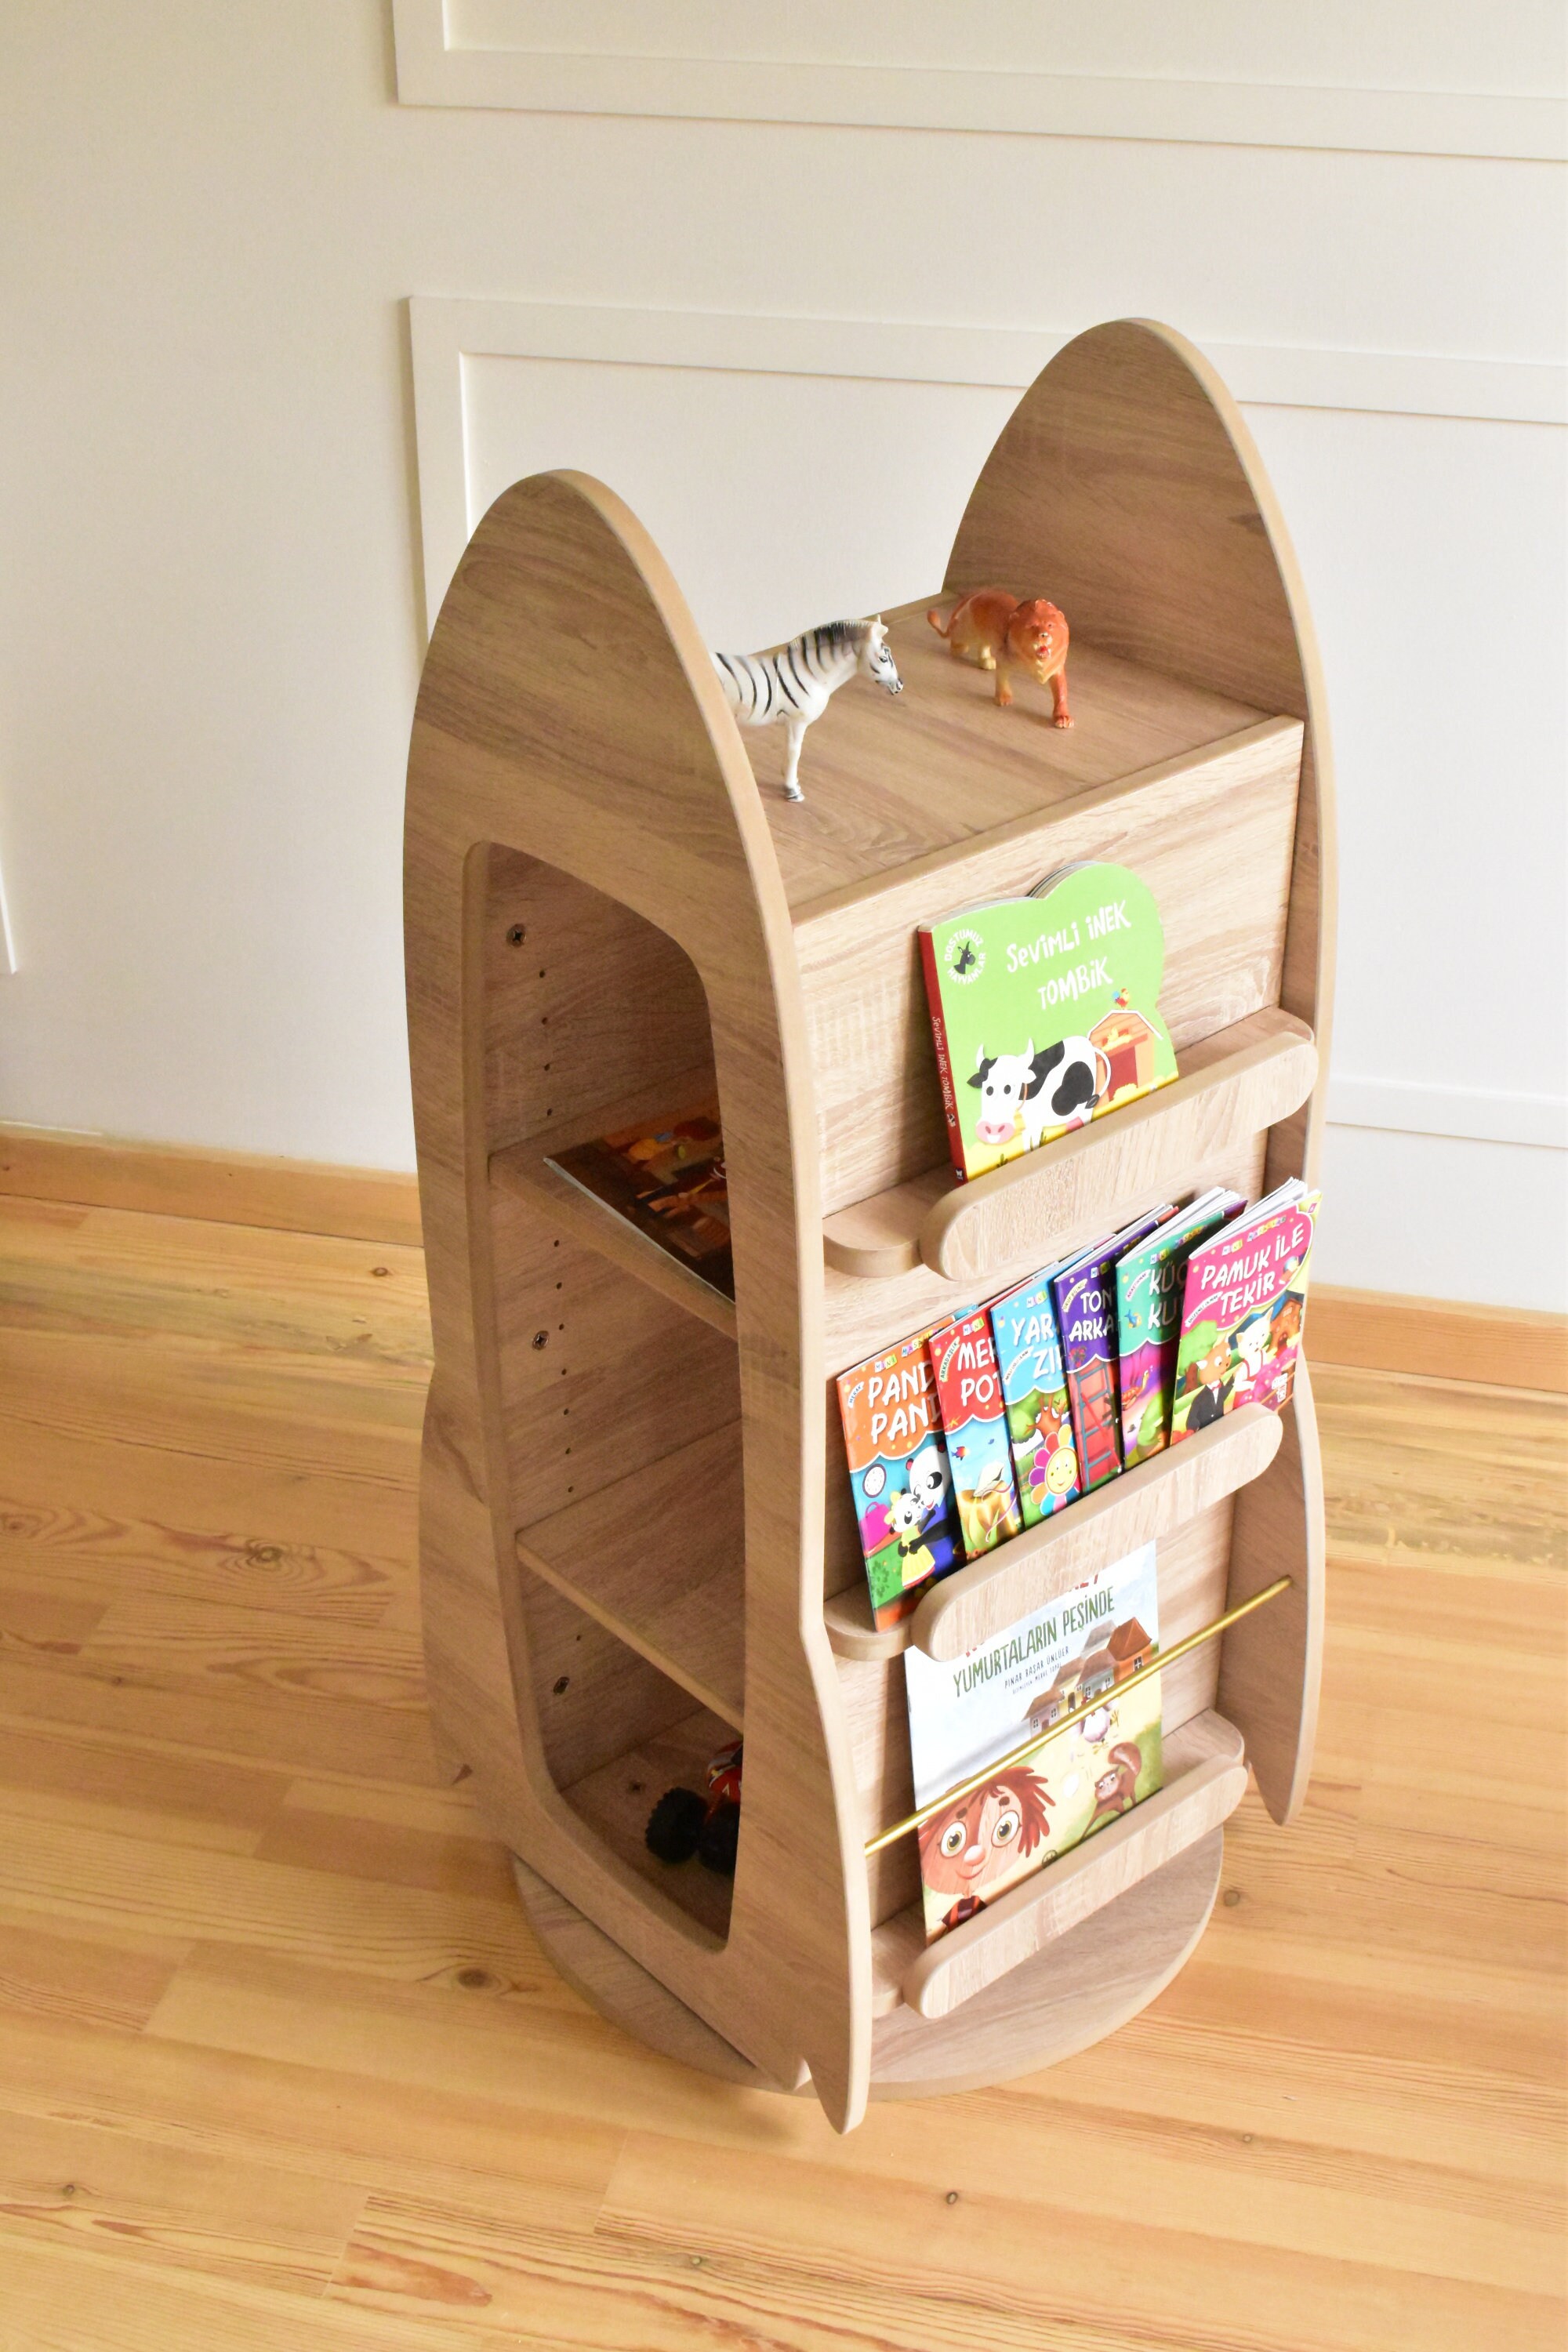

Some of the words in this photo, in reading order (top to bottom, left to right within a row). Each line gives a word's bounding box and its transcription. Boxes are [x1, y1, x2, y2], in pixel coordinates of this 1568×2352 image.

[944, 929, 983, 961] DOSTUMUZ
[947, 953, 985, 985] HAYVANLAR
[1201, 1245, 1271, 1290] PAMUK
[1275, 1223, 1304, 1261] İLE
[1080, 1288, 1114, 1314] TON
[1221, 1271, 1275, 1316] TEKİR
[1011, 1312, 1057, 1346] YAR
[1069, 1315, 1114, 1341] ARKA
[1148, 1298, 1178, 1330] KU
[953, 1617, 1057, 1697] YUMURTALARIN
[1063, 1586, 1115, 1636] PEŞİNDE
